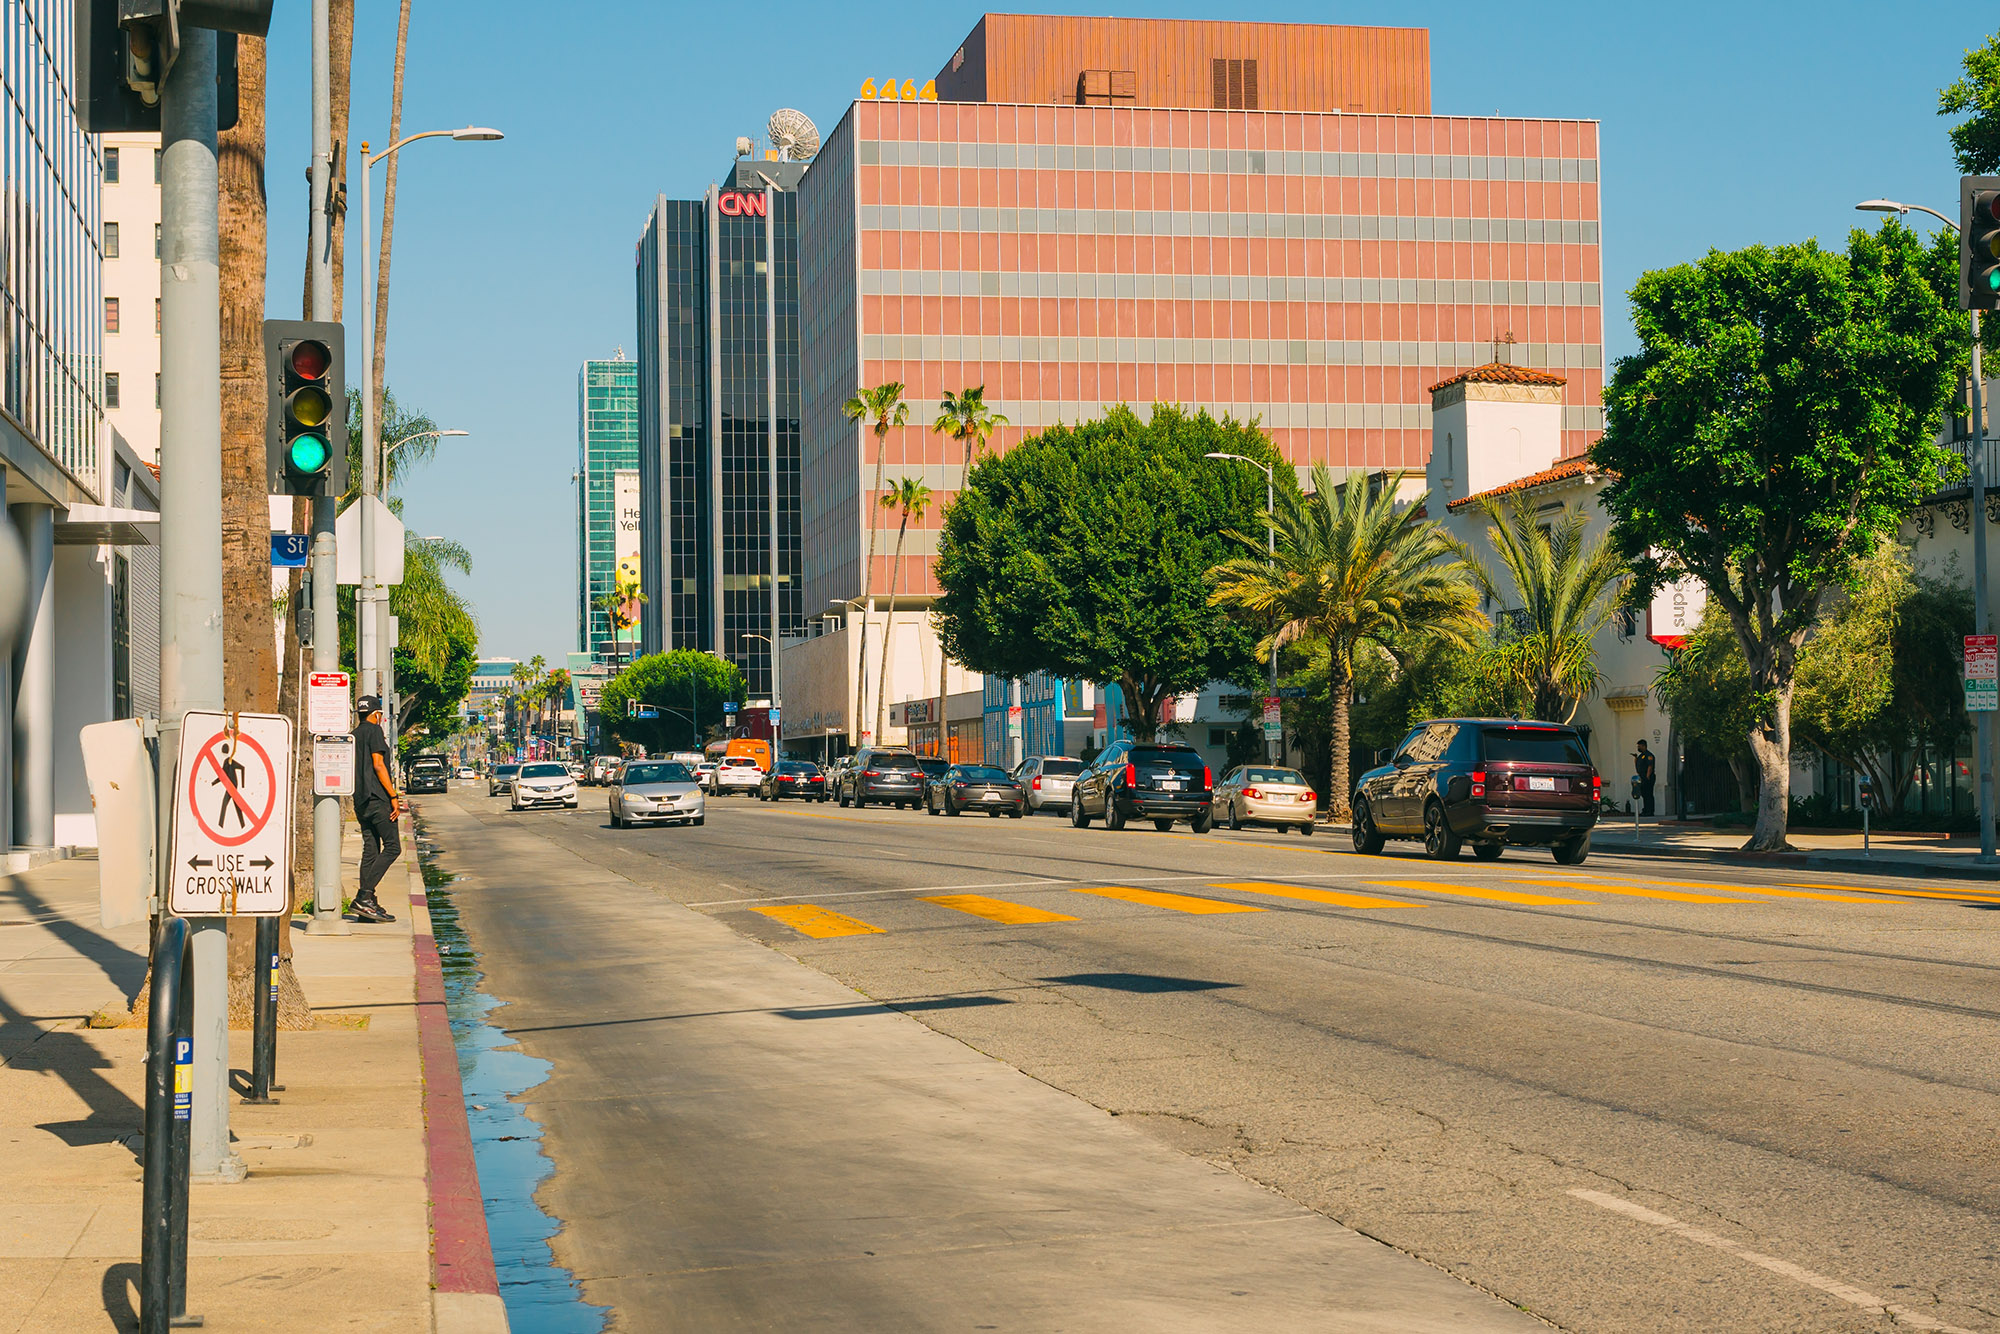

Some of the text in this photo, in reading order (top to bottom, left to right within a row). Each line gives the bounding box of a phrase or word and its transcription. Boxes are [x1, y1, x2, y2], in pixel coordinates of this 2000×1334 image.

[860, 77, 938, 101] 6464
[718, 192, 767, 217] CNN
[287, 537, 304, 553] St
[1968, 680, 1974, 689] 2
[217, 855, 245, 872] USE
[186, 876, 273, 895] CROSSWALK
[271, 955, 278, 968] P
[177, 1041, 189, 1061] P
